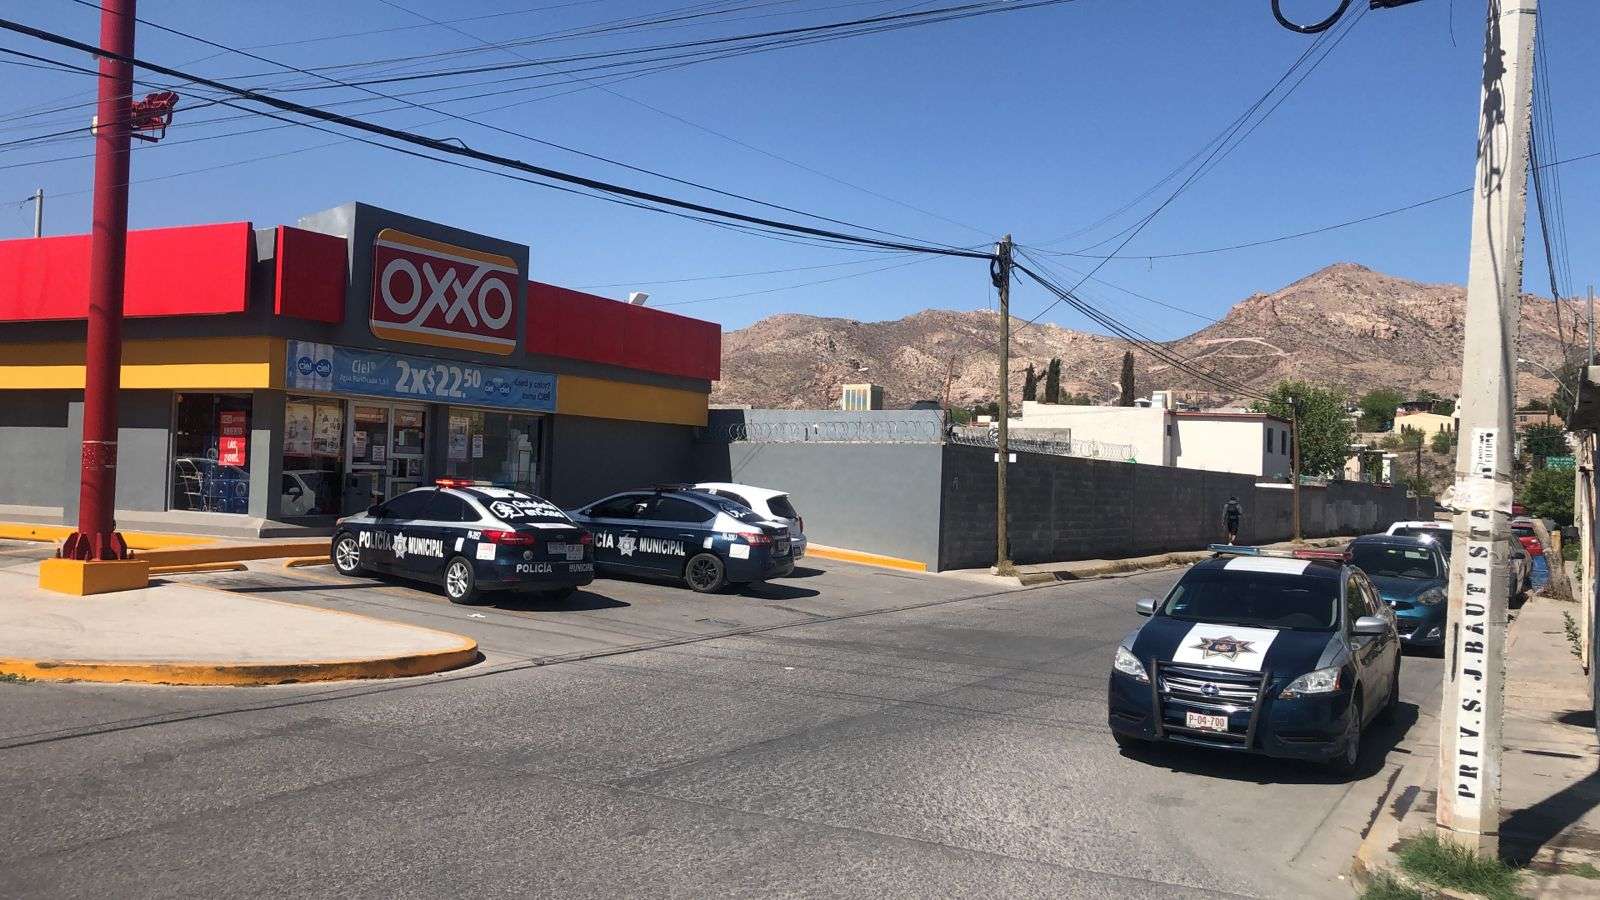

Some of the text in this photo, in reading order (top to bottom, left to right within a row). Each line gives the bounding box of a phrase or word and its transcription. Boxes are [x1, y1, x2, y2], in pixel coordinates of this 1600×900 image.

[381, 258, 513, 330] OXXO
[359, 530, 444, 558] POLICÍA MUNICIPAL
[639, 537, 686, 557] MUNICIPAL
[516, 562, 552, 573] POLICÍA
[1189, 714, 1225, 727] P-04-700
